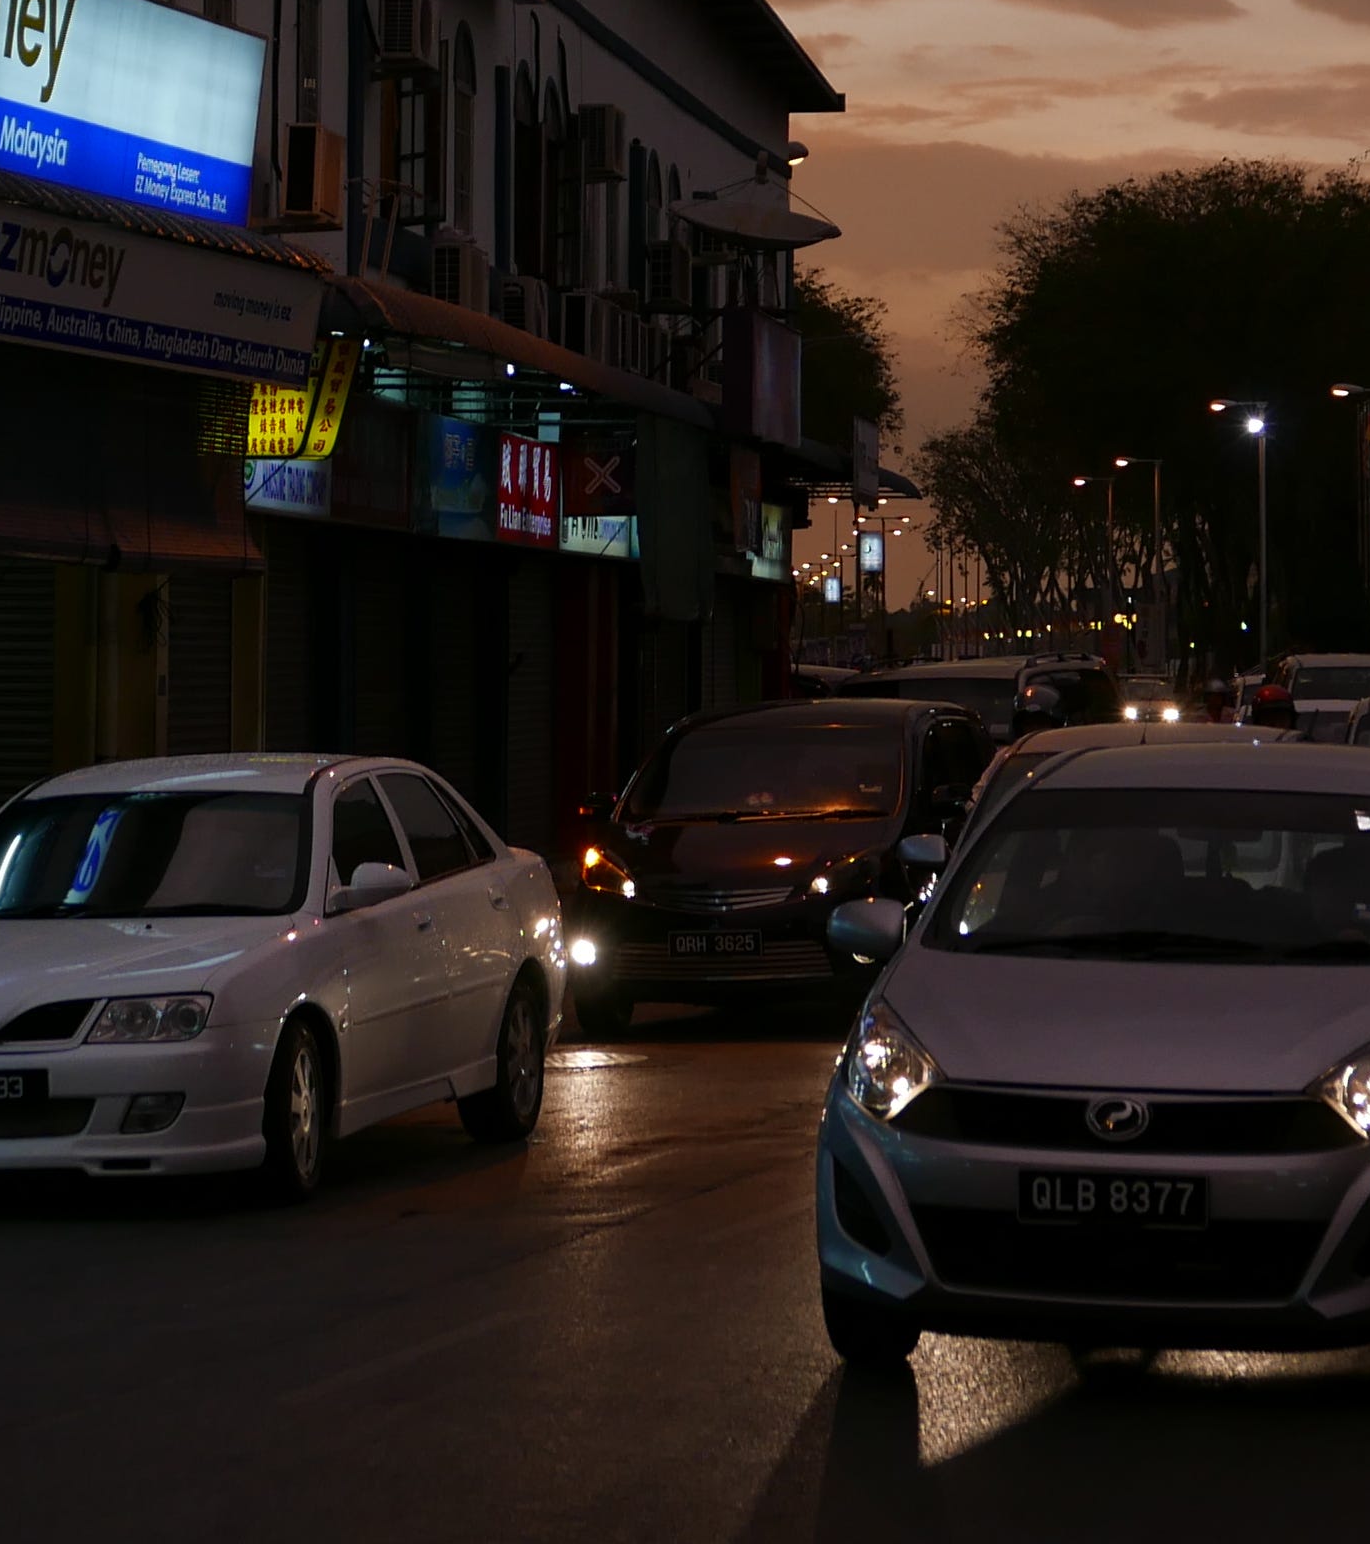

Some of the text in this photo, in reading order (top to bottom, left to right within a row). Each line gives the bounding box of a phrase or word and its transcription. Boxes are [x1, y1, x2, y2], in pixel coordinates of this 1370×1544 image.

[0, 115, 68, 169] Malaysia
[137, 152, 177, 181] Pemegang
[135, 174, 144, 194] EZ
[144, 176, 170, 203] Money
[170, 183, 196, 206] Express
[213, 290, 245, 316] moving
[245, 296, 274, 322] money
[281, 306, 292, 322] ez
[45, 306, 103, 343] Australia,
[105, 317, 141, 350] China,
[143, 324, 209, 360] Bangladesh
[210, 335, 233, 363] Dan
[233, 342, 274, 370] Seluruh
[274, 351, 306, 377] Dunia
[676, 934, 755, 953] QRH 3625
[1031, 1176, 1194, 1216] QLB 8377
